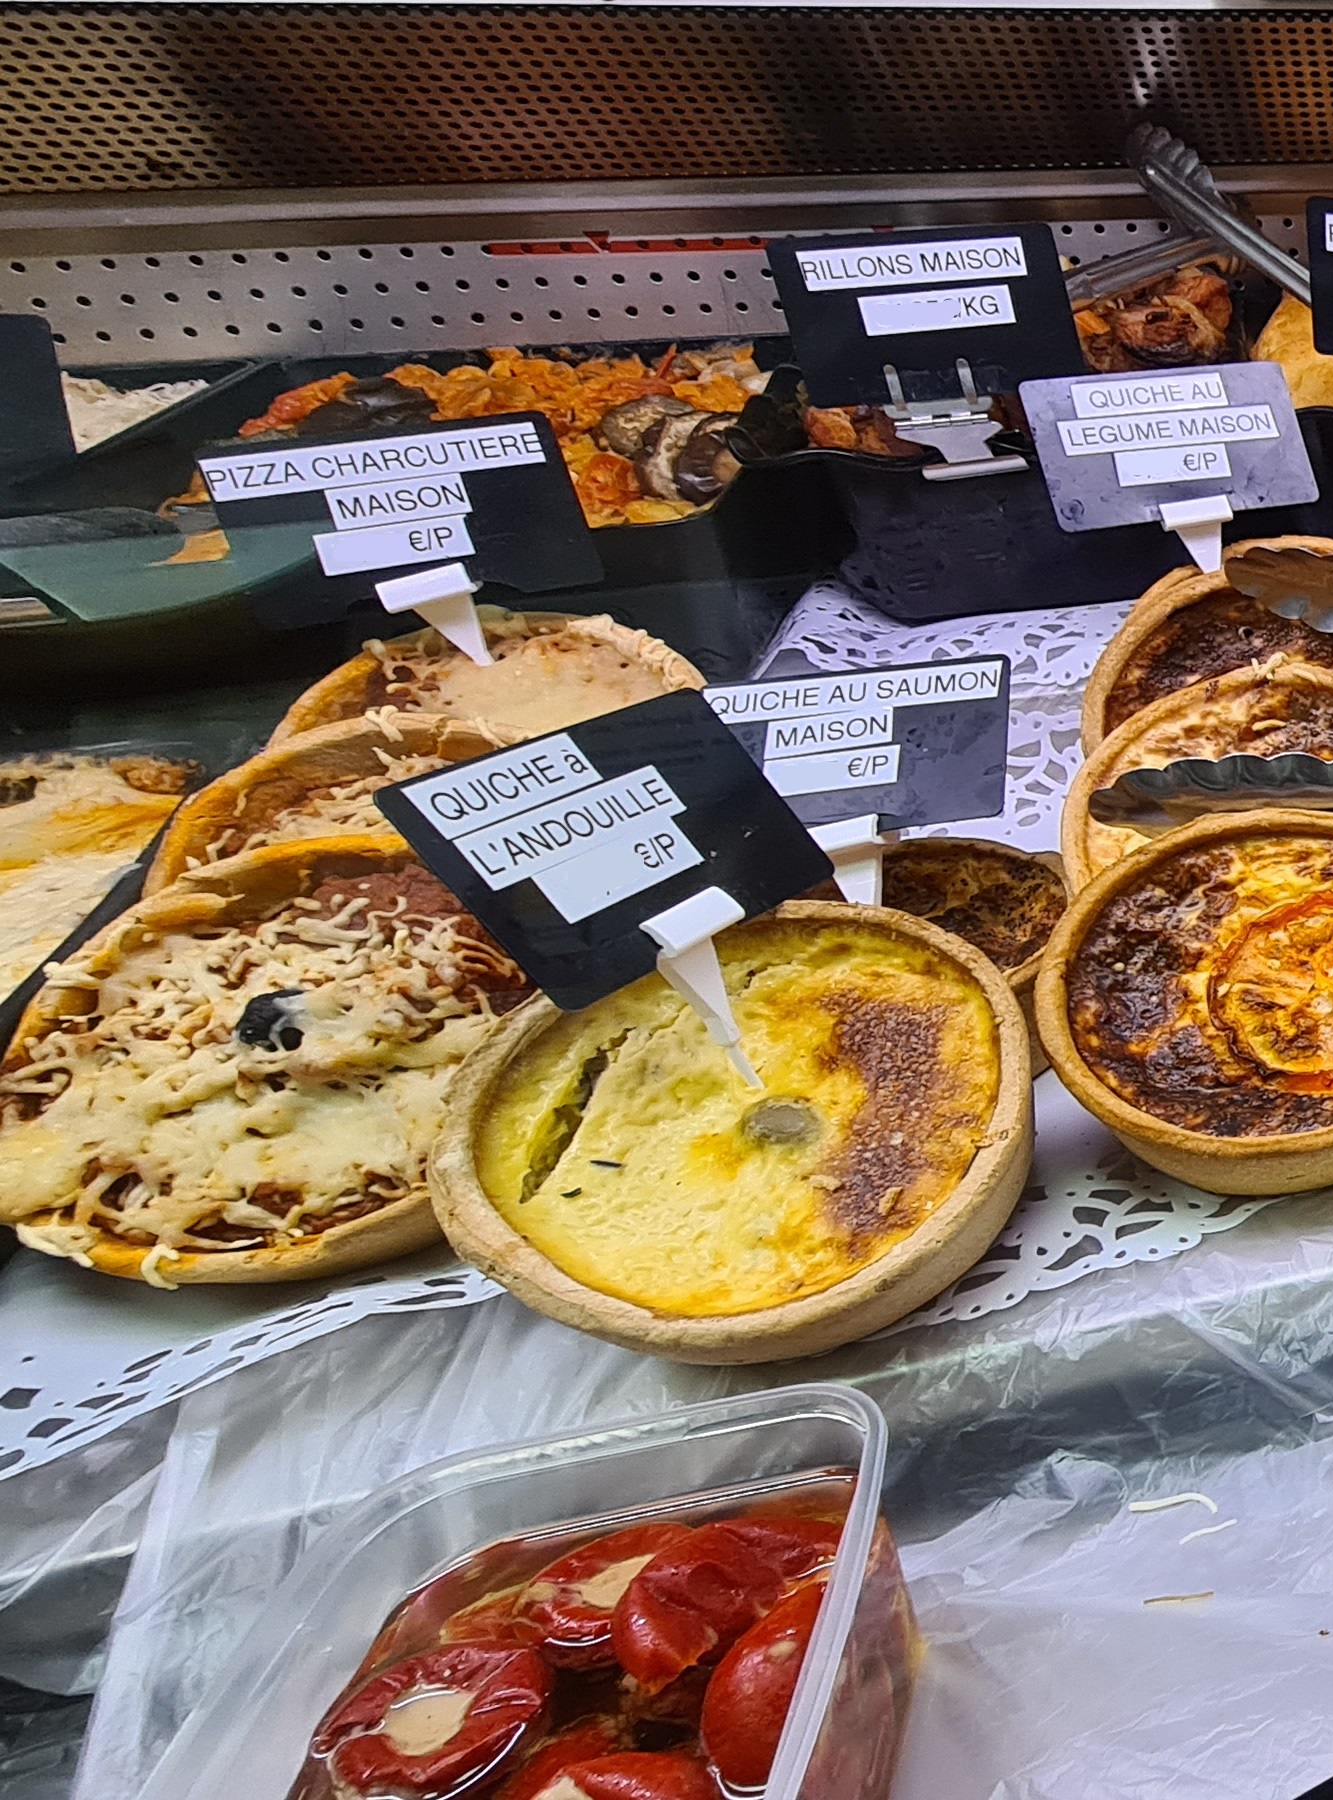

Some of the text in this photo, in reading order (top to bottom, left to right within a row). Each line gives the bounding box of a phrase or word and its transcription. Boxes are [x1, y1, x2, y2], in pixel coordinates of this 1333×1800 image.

[800, 246, 1022, 281] RILLONS MAISON
[1088, 381, 1223, 409] QUICHE AU
[1066, 412, 1272, 447] LEGUME MAISON
[205, 432, 543, 492] PIZZA CHARCUTIERE
[335, 482, 467, 520] MAISON
[709, 669, 998, 717] QUICHE AU SAUMON
[774, 714, 888, 749] MAISON
[430, 754, 566, 822] QUICHE
[469, 778, 674, 876] L'ANDOUILLE
